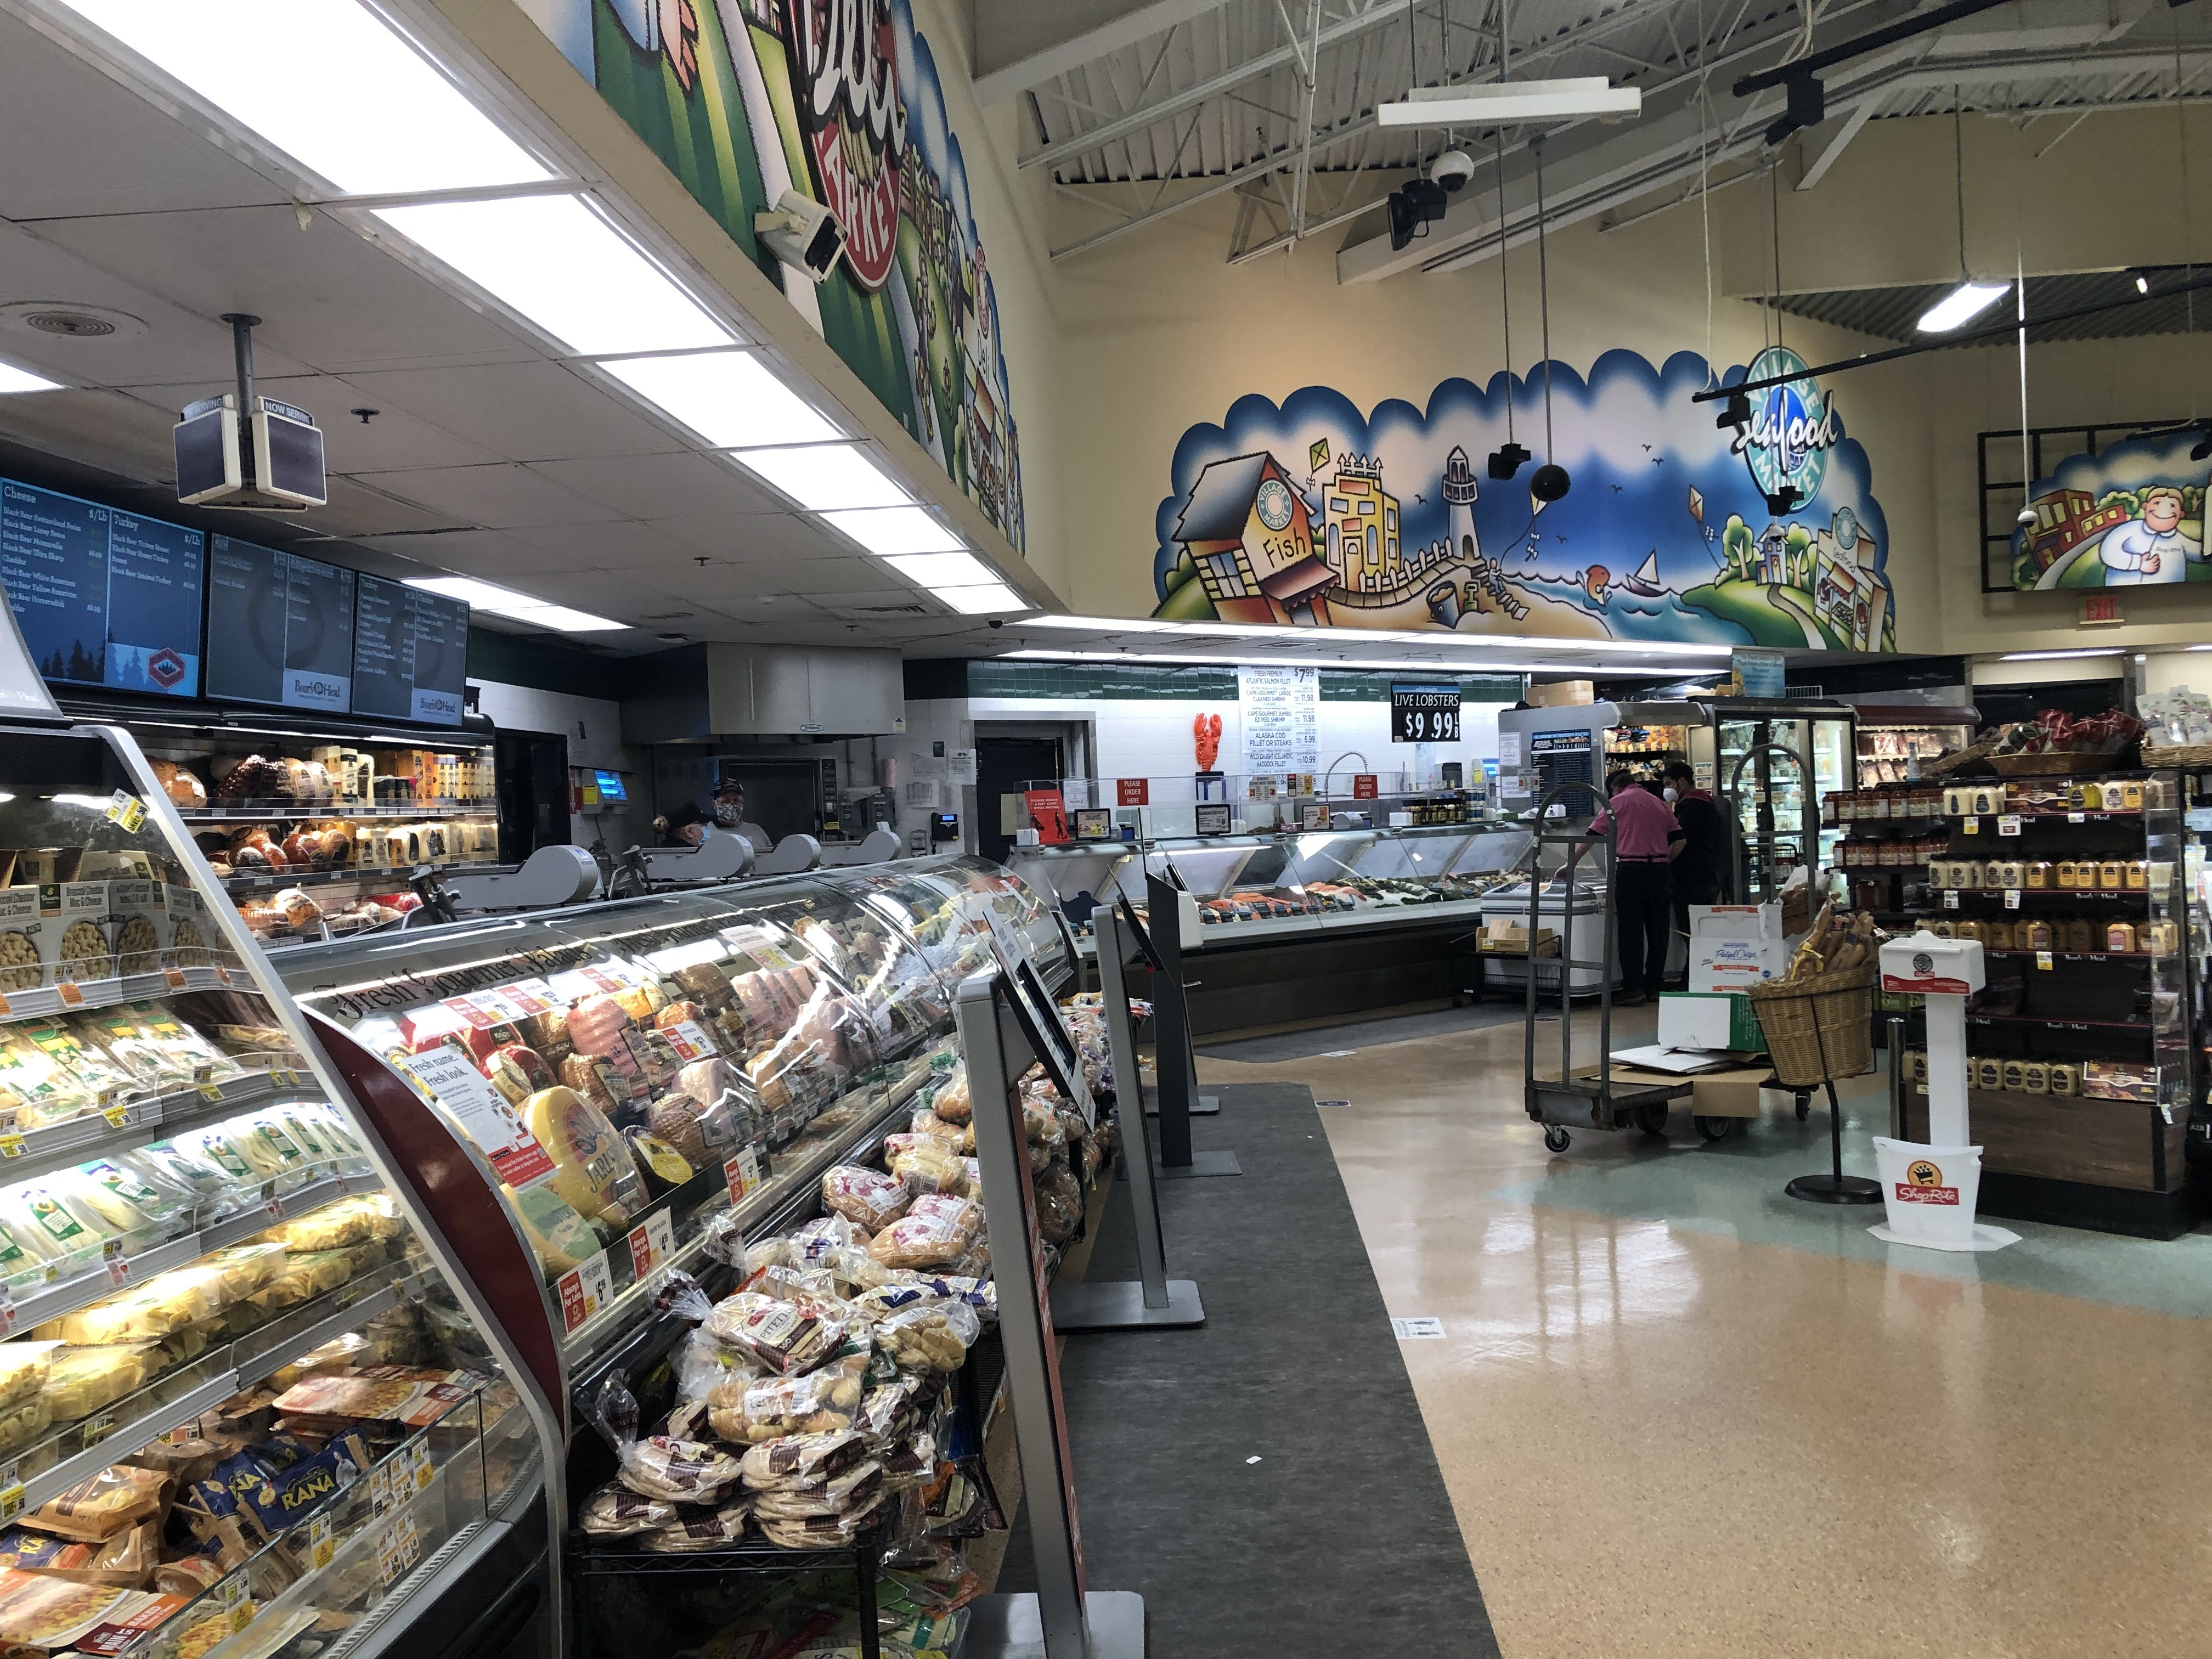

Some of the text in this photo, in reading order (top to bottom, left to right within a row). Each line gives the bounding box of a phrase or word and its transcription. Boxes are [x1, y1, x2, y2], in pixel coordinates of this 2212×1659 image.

[265, 402, 310, 423] NOW SERVING
[4, 486, 37, 504] Cheese
[1259, 483, 1287, 501] VILLAGE
[114, 514, 139, 531] Turkey
[1264, 509, 1290, 526] MARKET
[1262, 527, 1306, 569] Fish
[2086, 595, 2117, 621] EXIT
[324, 684, 341, 698] Head
[1395, 695, 1459, 707] LIVE LOBSTERS
[1715, 949, 1736, 960] Pretzel
[315, 941, 592, 1019] Fresh Gourmet Salads
[408, 1053, 459, 1074] Fresh name.
[422, 1066, 469, 1087] Fresh look.
[1899, 1187, 1956, 1204] ShopRite
[634, 1235, 646, 1249] Always
[634, 1249, 642, 1259] For
[563, 1283, 580, 1297] Always
[564, 1297, 573, 1308] For
[778, 1337, 792, 1351] 160
[280, 1474, 336, 1511] RANA
